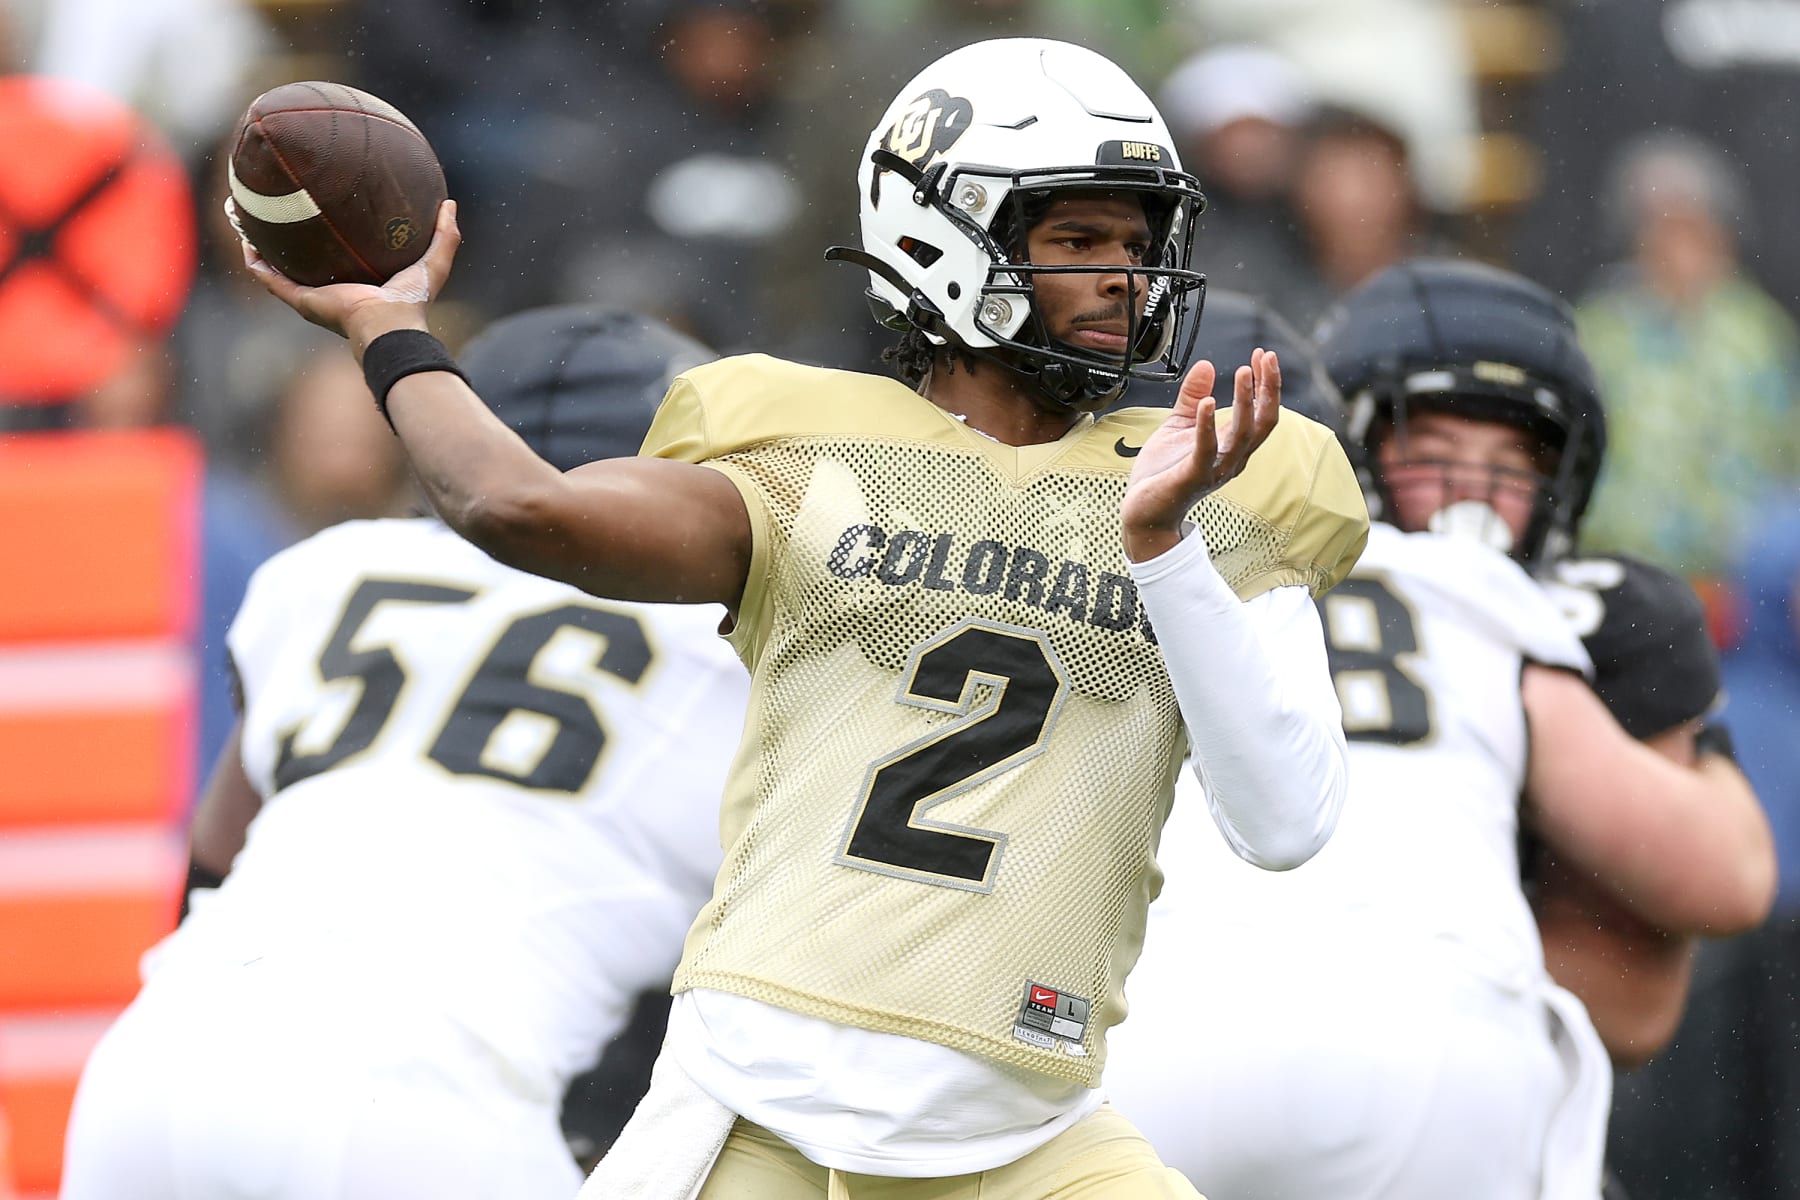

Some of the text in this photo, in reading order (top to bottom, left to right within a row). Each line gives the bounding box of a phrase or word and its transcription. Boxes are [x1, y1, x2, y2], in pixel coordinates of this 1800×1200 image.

[1121, 142, 1160, 161] BUFFS
[273, 571, 658, 797] 56
[832, 616, 1071, 895] 2
[1031, 1003, 1054, 1014] TEAM
[1067, 1001, 1075, 1016] L
